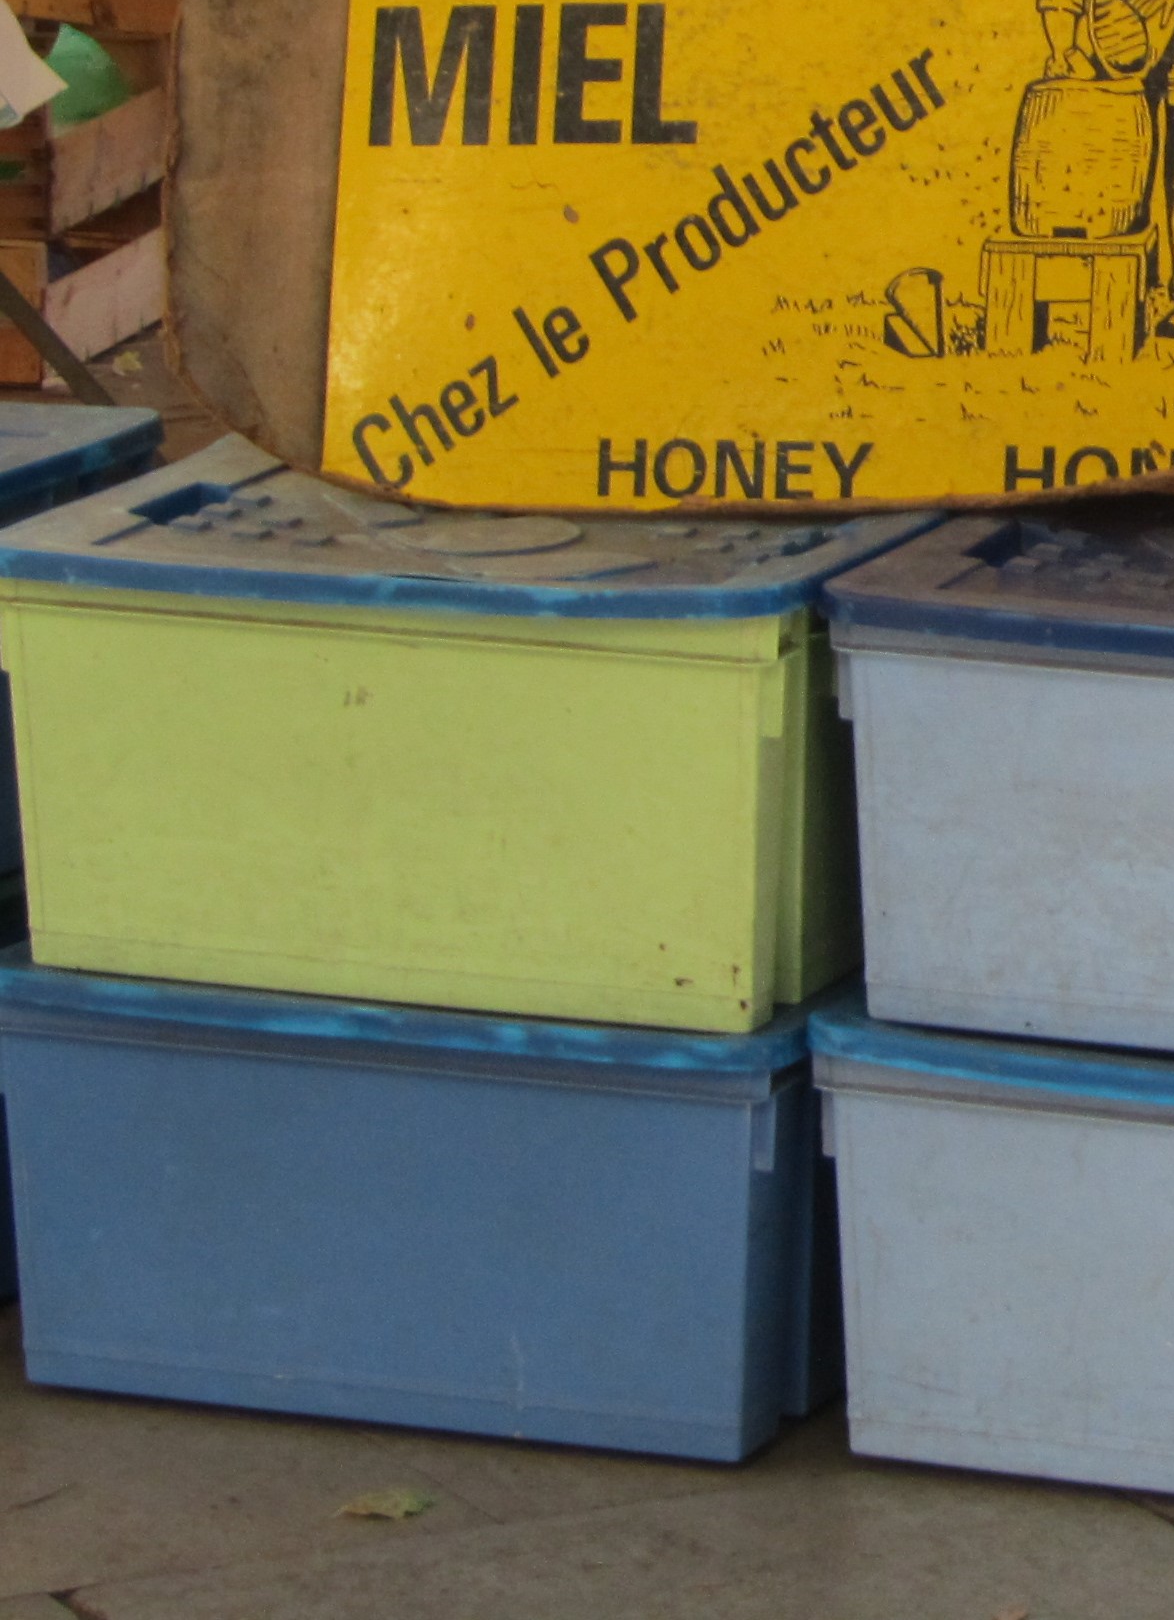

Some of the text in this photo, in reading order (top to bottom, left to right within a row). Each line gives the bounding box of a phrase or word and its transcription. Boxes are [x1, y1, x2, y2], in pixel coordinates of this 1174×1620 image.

[368, 2, 698, 147] MIEL
[350, 46, 946, 489] Chez le Producteur
[597, 438, 875, 500] HONEY
